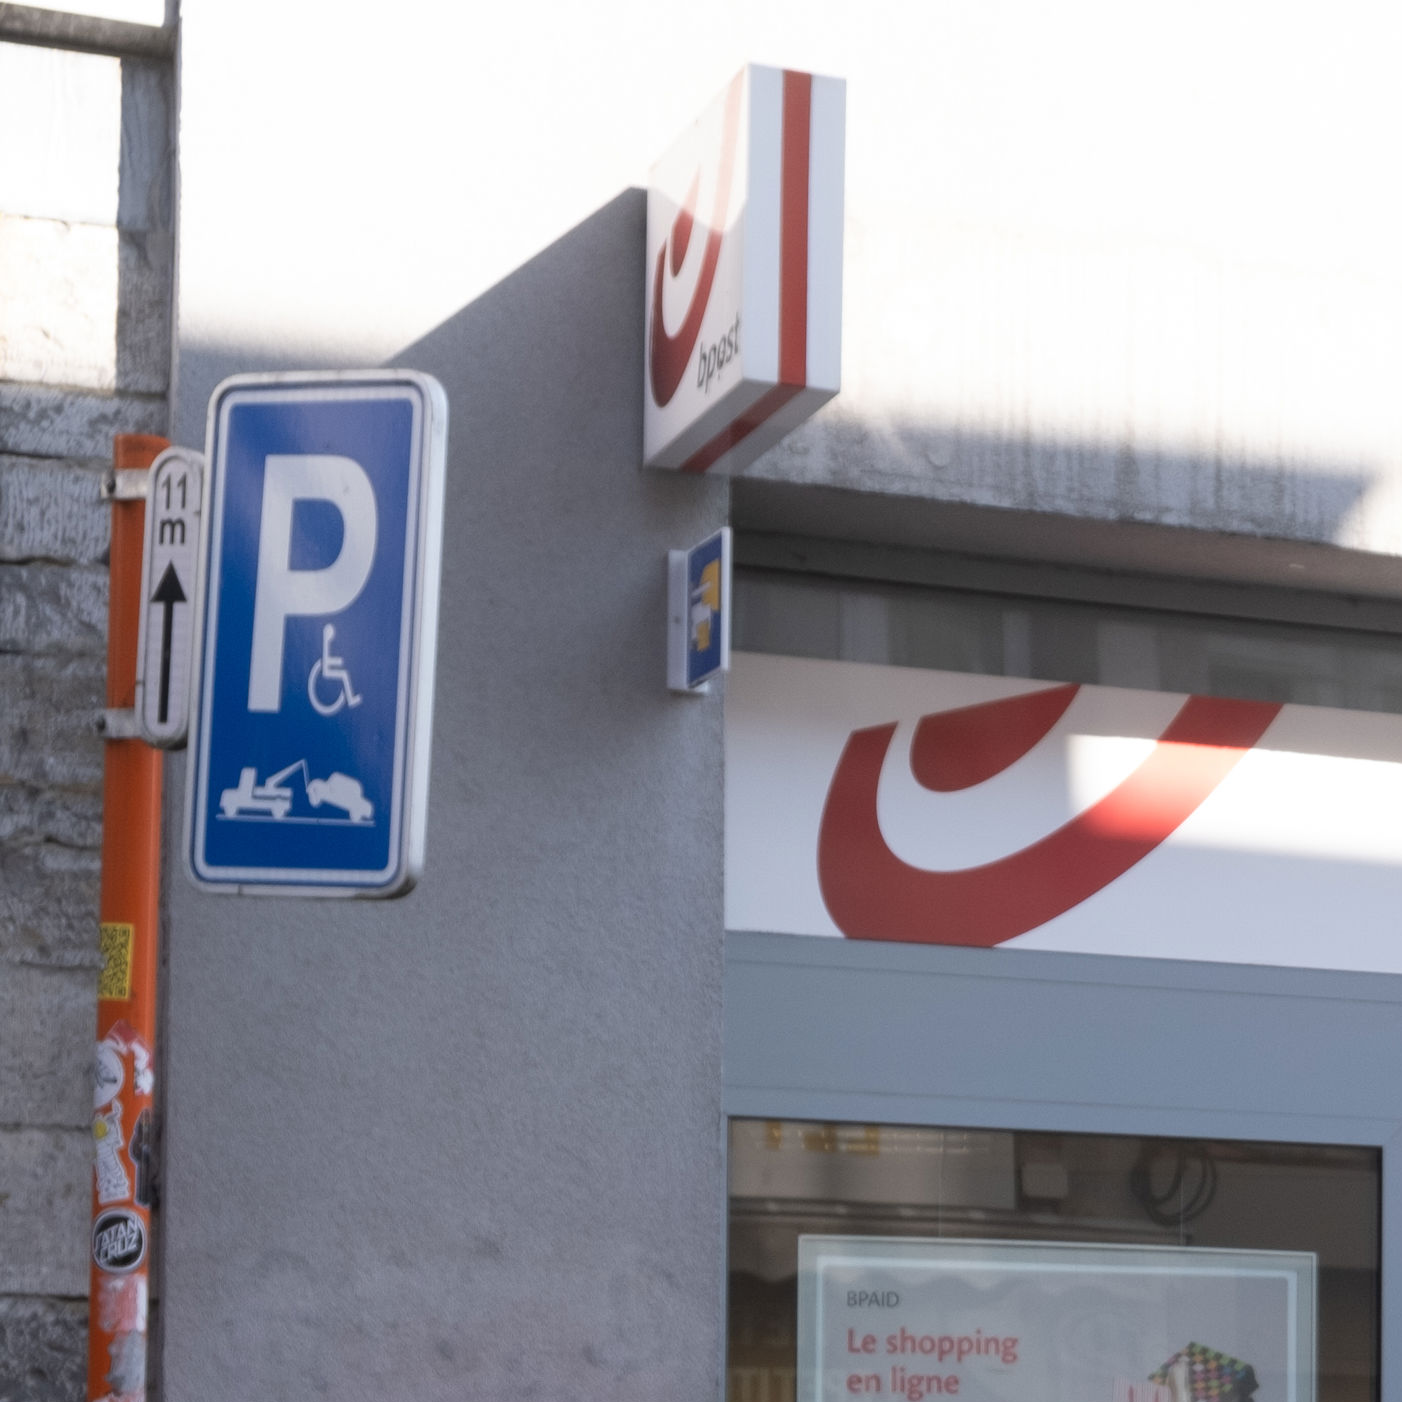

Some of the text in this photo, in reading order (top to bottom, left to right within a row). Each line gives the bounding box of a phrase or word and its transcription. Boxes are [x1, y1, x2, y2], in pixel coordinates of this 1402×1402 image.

[697, 312, 741, 394] bpost
[161, 472, 188, 511] 11
[159, 517, 186, 546] m
[247, 453, 378, 713] P
[847, 1290, 900, 1308] BPAID
[847, 1325, 1019, 1364] Le shopping
[846, 1366, 960, 1402] en ligne
